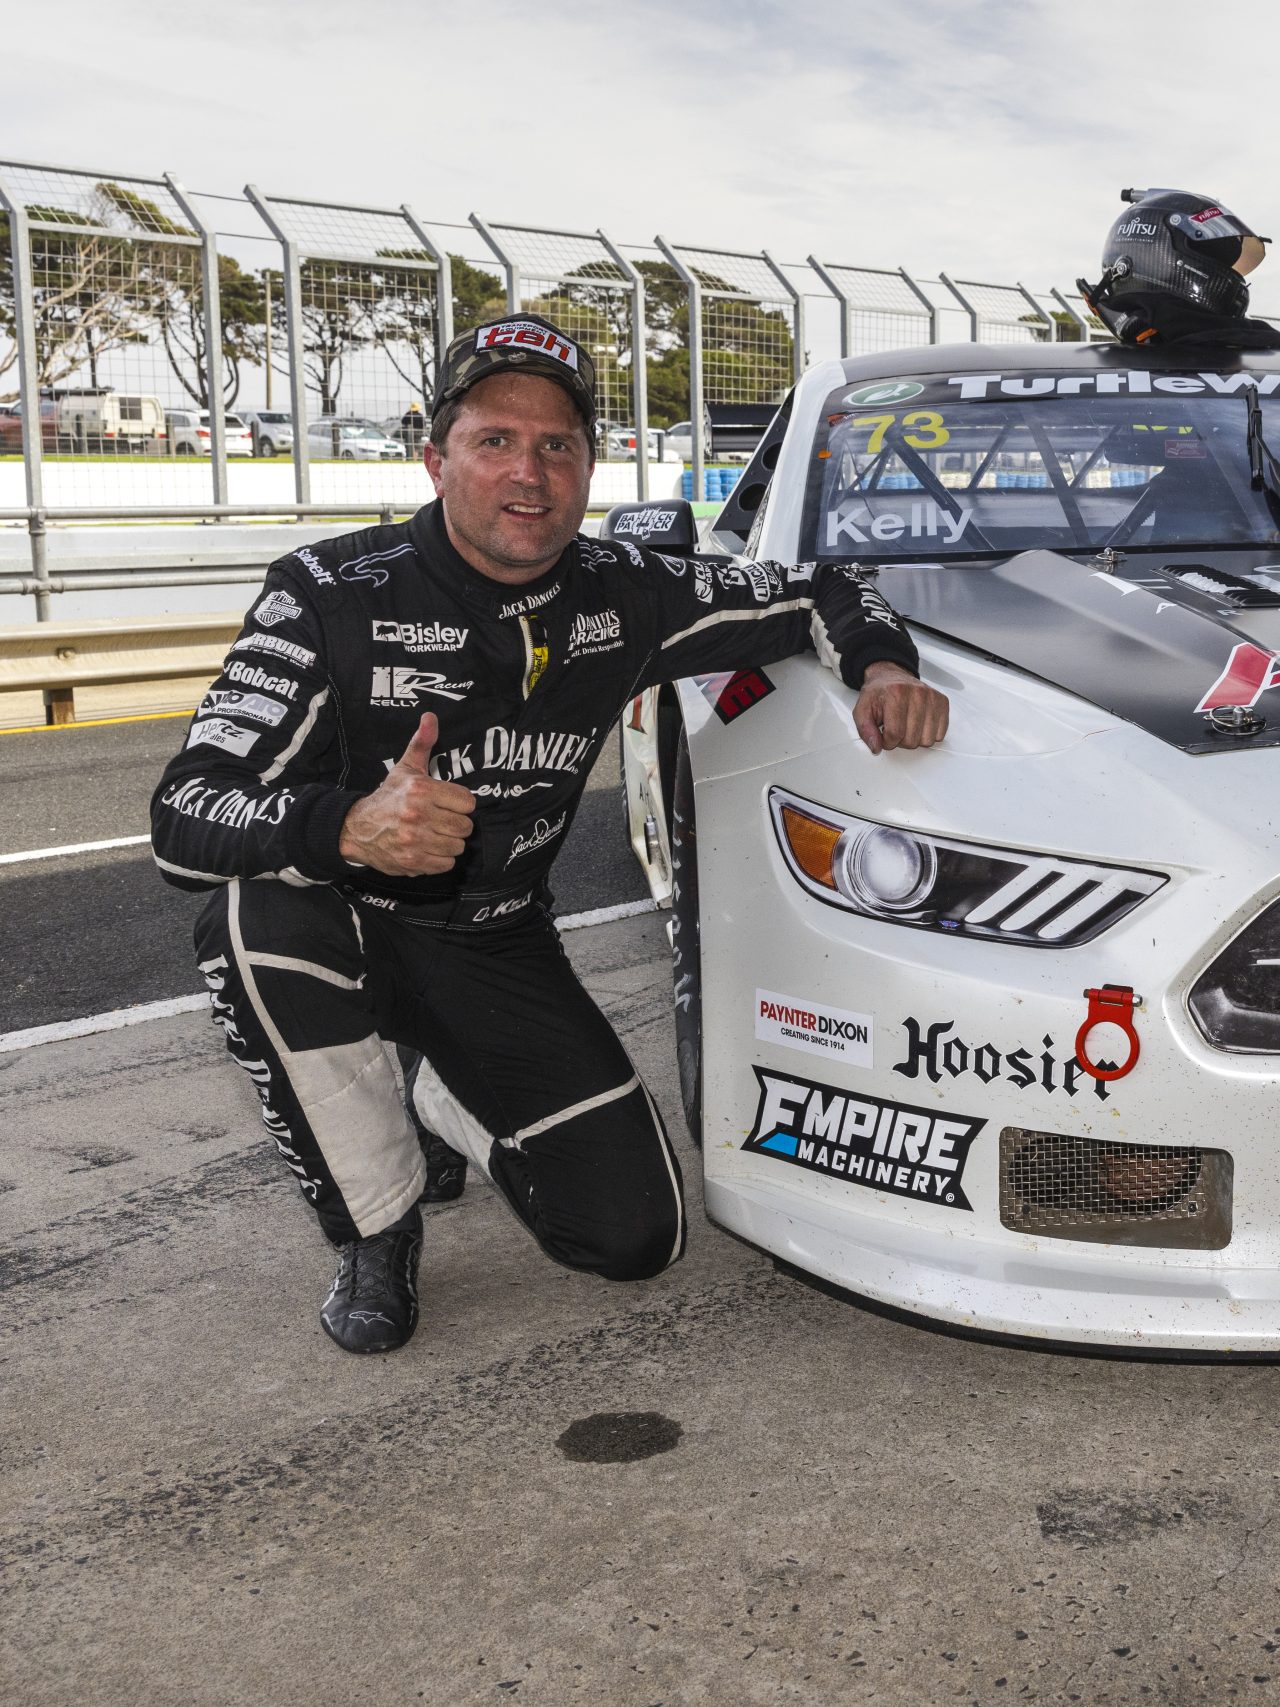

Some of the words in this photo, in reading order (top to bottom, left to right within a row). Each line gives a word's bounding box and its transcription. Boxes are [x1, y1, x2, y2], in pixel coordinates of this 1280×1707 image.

[1118, 217, 1156, 237] FUJITSU
[853, 412, 950, 454] 73
[826, 503, 973, 547] Kelly
[293, 548, 335, 586] Sabelt
[499, 600, 526, 620] JACK
[525, 582, 561, 610] DANIEL'S
[401, 622, 469, 649] Bisley
[404, 643, 457, 653] WORKWEAR
[577, 625, 620, 646] RACING
[229, 661, 299, 701] Bobcat
[370, 699, 420, 708] KELLY
[209, 733, 227, 744] ales
[760, 1000, 816, 1031] PAYNTER
[818, 1016, 868, 1044] DIXON
[780, 1027, 809, 1041] CREATING
[810, 1034, 829, 1046] SINCE
[830, 1039, 845, 1052] 1914
[753, 1074, 973, 1172] EMPIRE
[799, 1140, 952, 1197] MACHINERY
